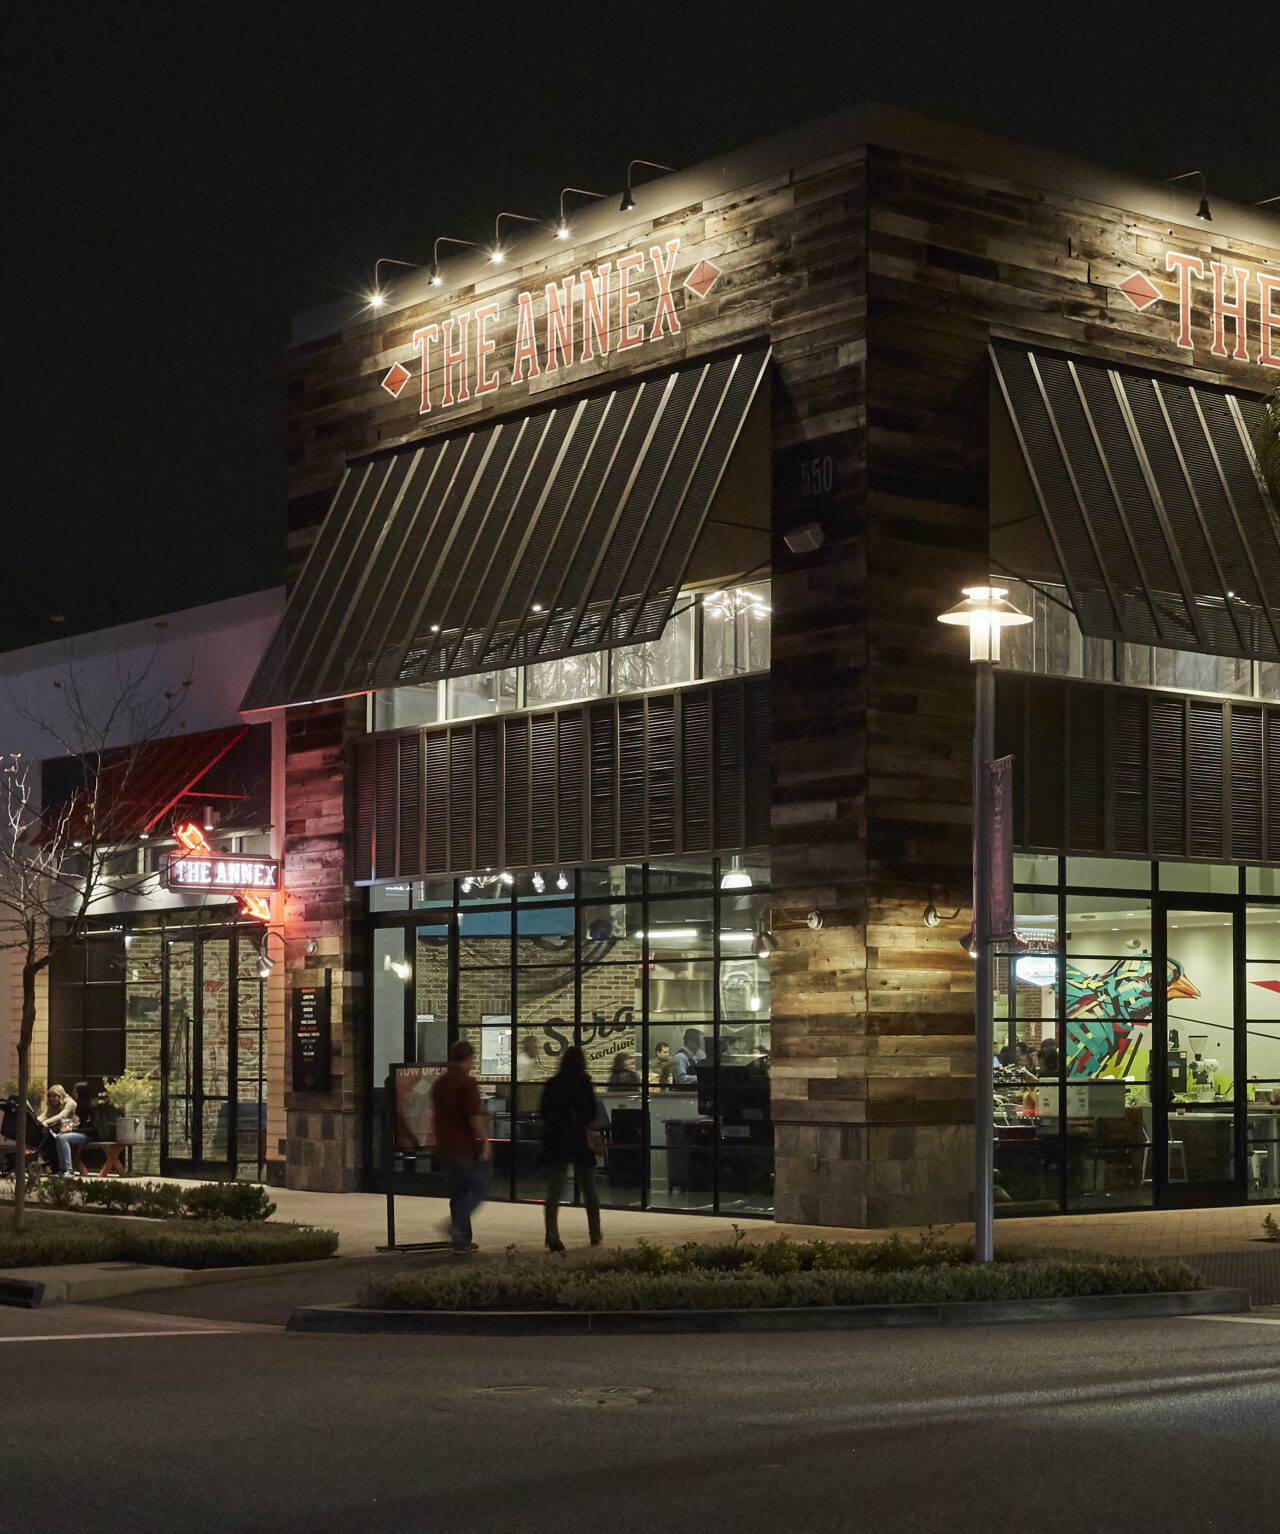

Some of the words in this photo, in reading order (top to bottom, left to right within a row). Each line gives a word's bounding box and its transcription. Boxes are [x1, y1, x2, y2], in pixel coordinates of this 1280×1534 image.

[412, 303, 500, 414] THE
[511, 238, 681, 385] ANNEX
[175, 861, 212, 883] THE
[215, 862, 277, 886] ANNEX
[1028, 941, 1052, 951] EAT
[396, 1068, 419, 1077] NOW
[422, 1066, 448, 1076] OPEN
